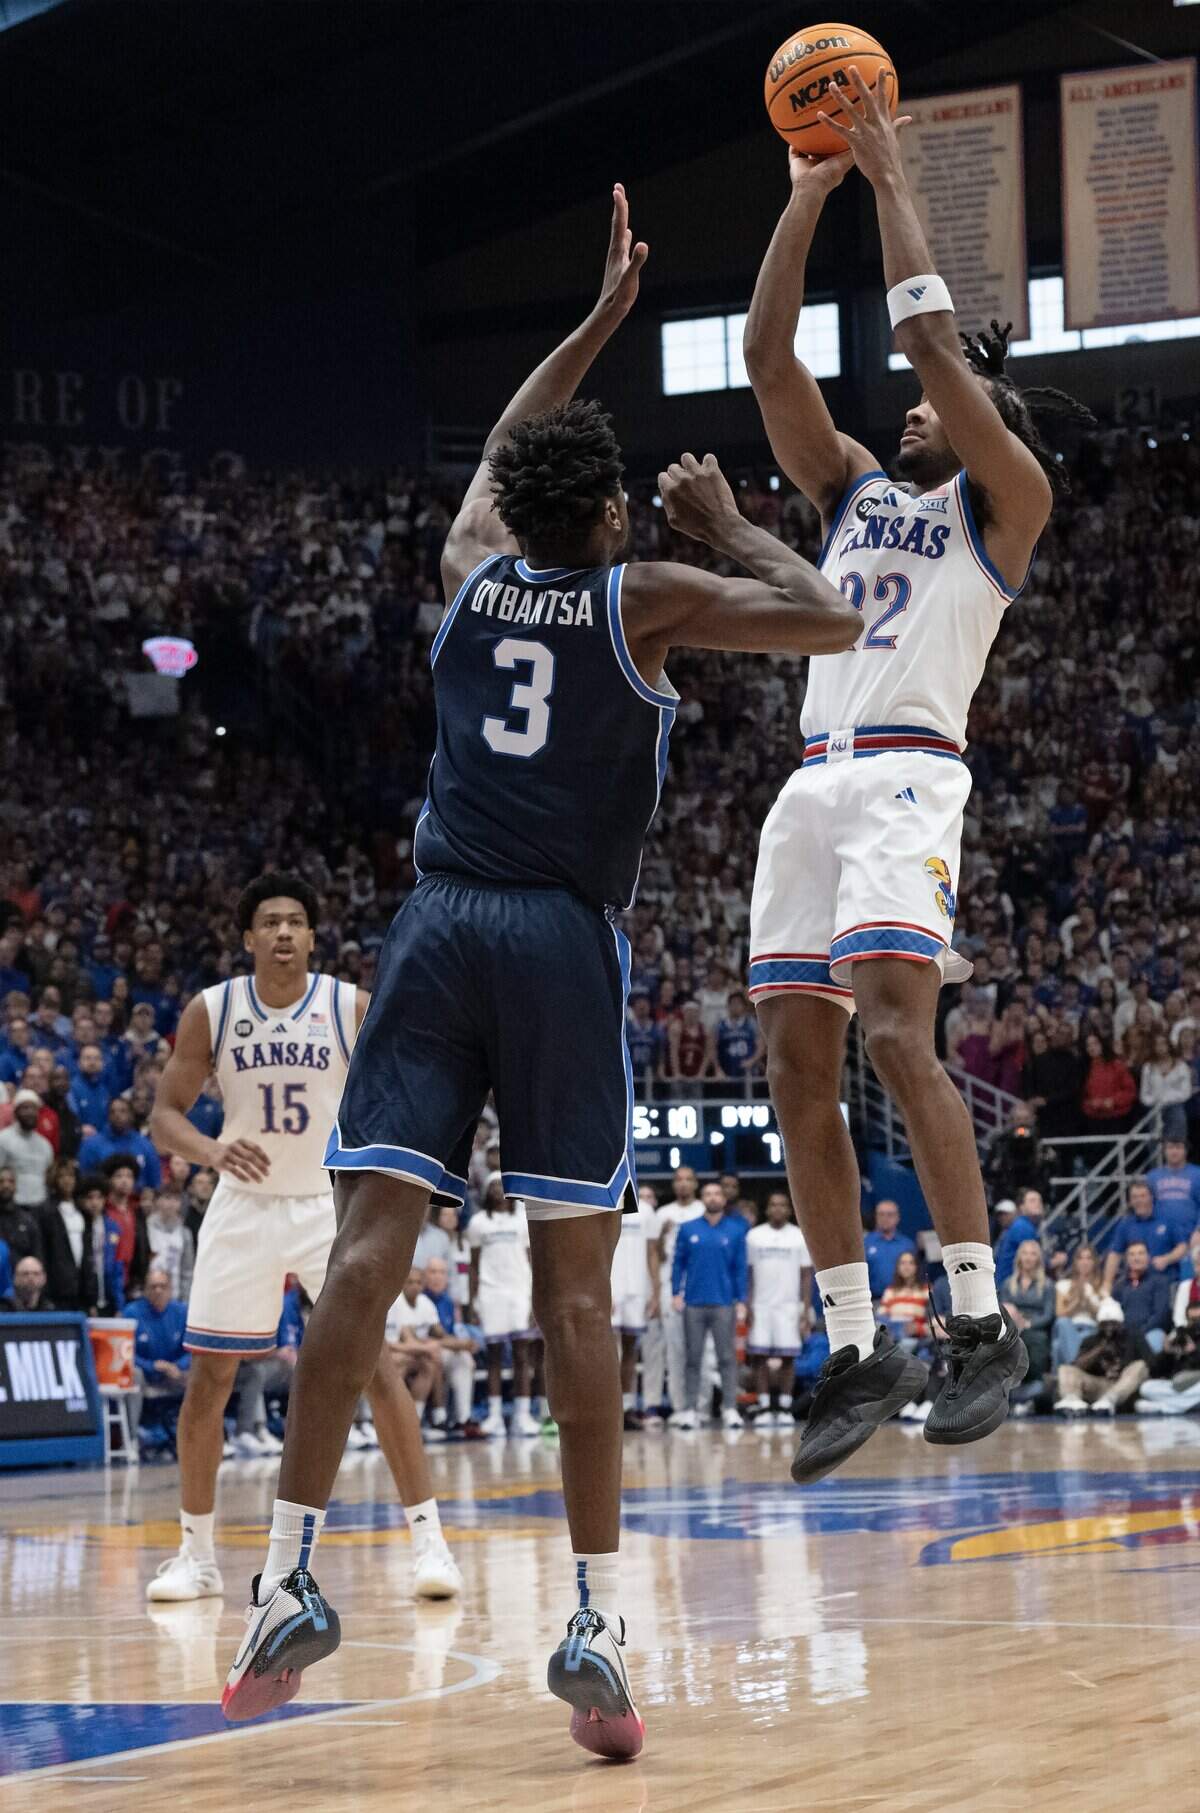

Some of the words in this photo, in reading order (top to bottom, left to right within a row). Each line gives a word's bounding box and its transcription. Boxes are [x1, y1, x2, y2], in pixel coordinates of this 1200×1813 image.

[769, 36, 850, 83] Wilson
[789, 68, 851, 112] NCAA
[470, 578, 594, 627] DYBANTSA
[481, 637, 555, 759] 3
[230, 1041, 331, 1072] KANSAS
[257, 1082, 311, 1135] 15
[721, 1105, 769, 1128] BYU
[4, 1340, 86, 1402] MILK
